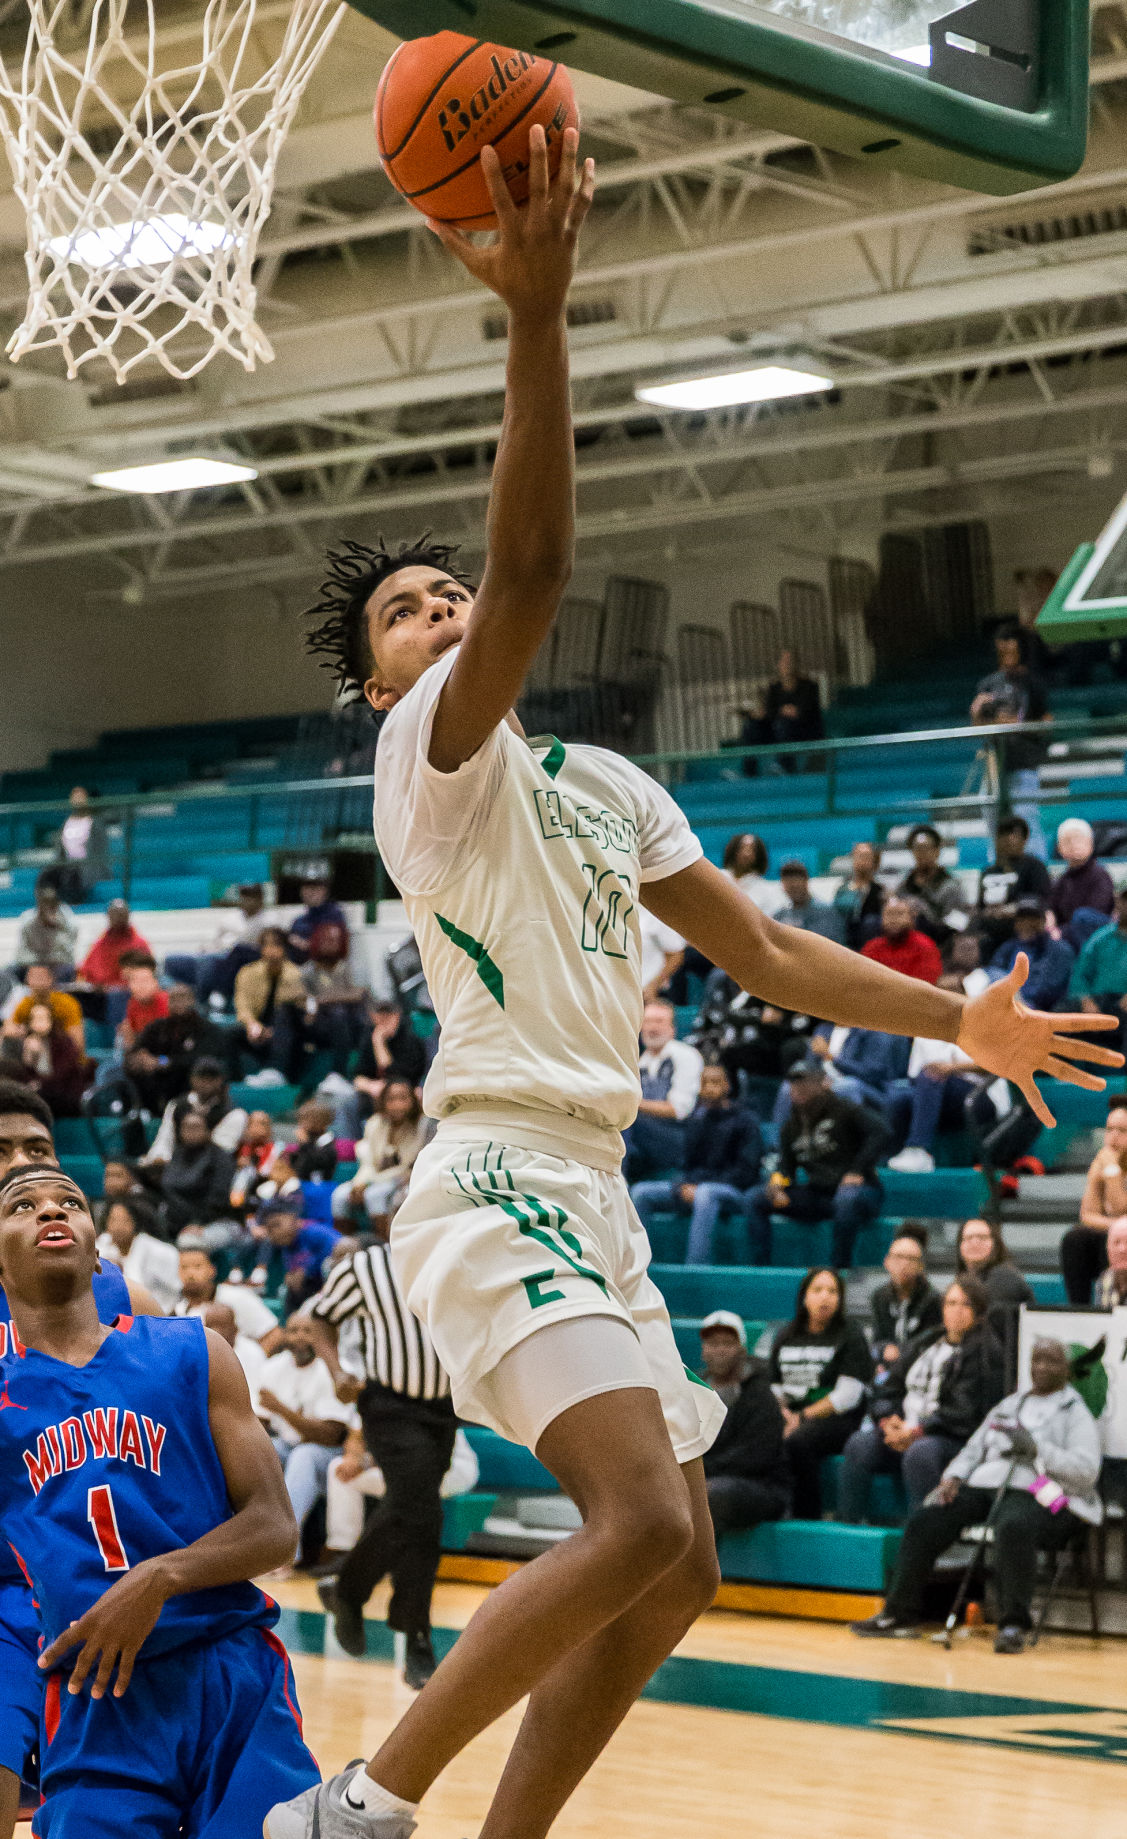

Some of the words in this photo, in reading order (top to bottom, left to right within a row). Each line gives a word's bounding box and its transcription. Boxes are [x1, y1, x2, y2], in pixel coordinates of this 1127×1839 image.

[438, 52, 536, 153] Baden
[22, 1407, 167, 1496] MIDWAY
[87, 1484, 130, 1572] 1
